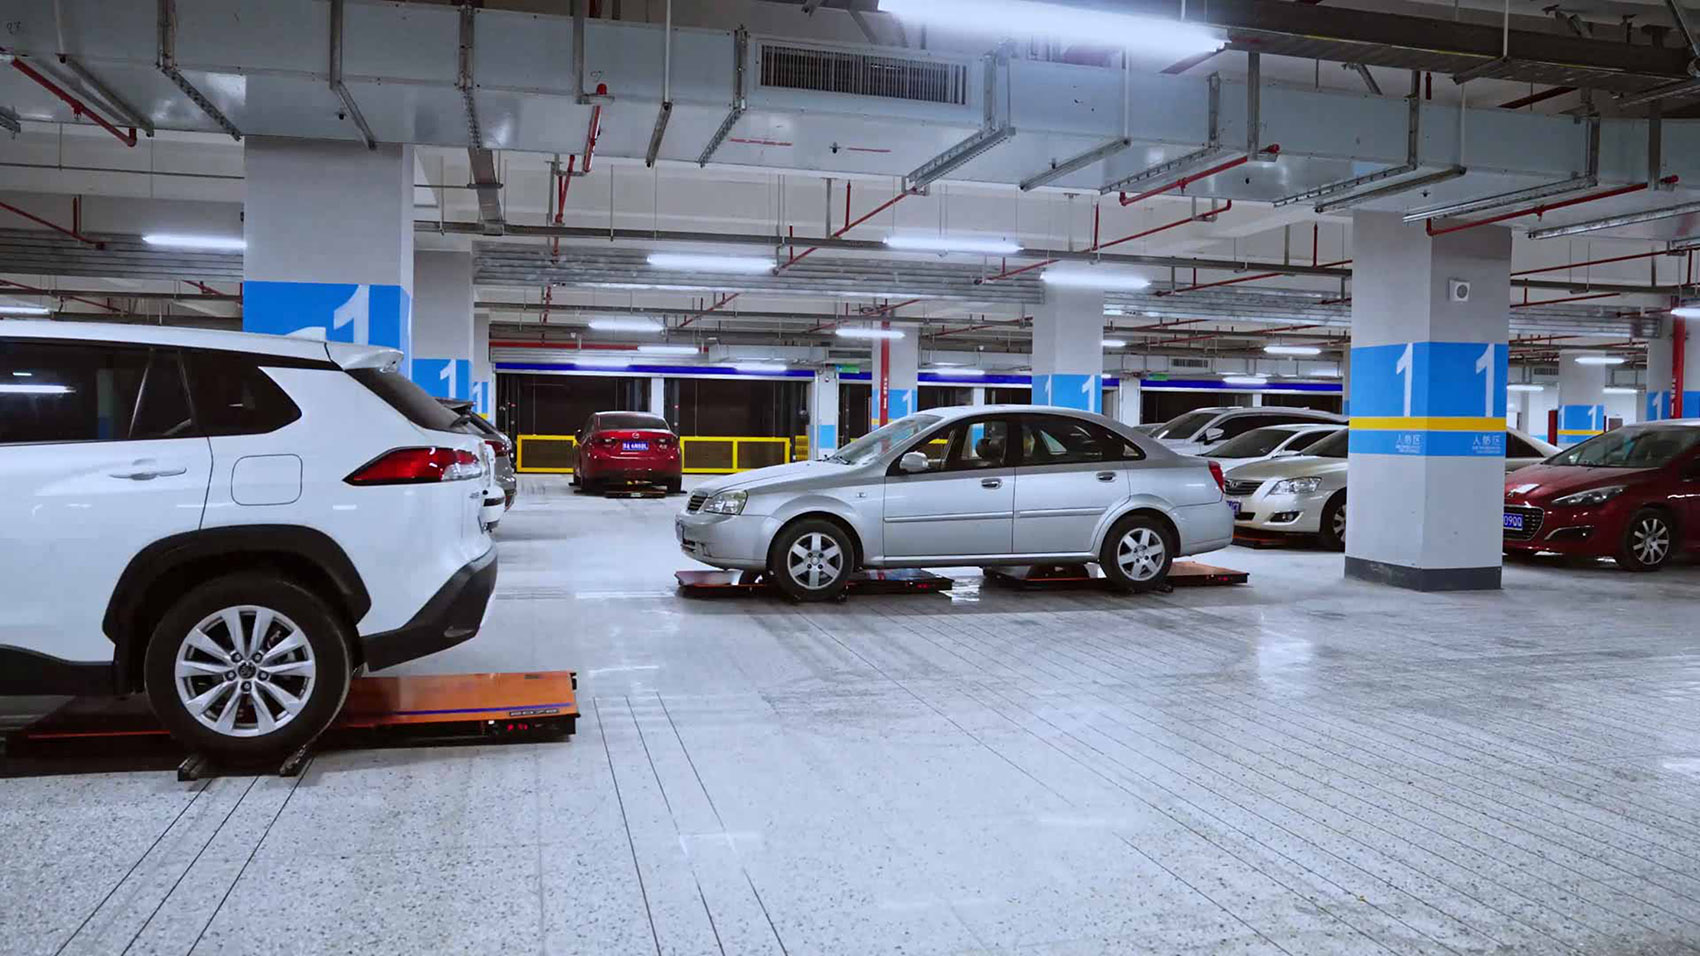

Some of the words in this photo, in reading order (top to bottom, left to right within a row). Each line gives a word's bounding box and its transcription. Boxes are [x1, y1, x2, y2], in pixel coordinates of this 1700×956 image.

[440, 359, 457, 398] 1
[1082, 374, 1095, 412] 1
[1396, 342, 1413, 417] 1
[1475, 343, 1495, 417] 1
[902, 389, 913, 416] 1
[1587, 405, 1598, 431] 1
[1652, 391, 1663, 420] 1
